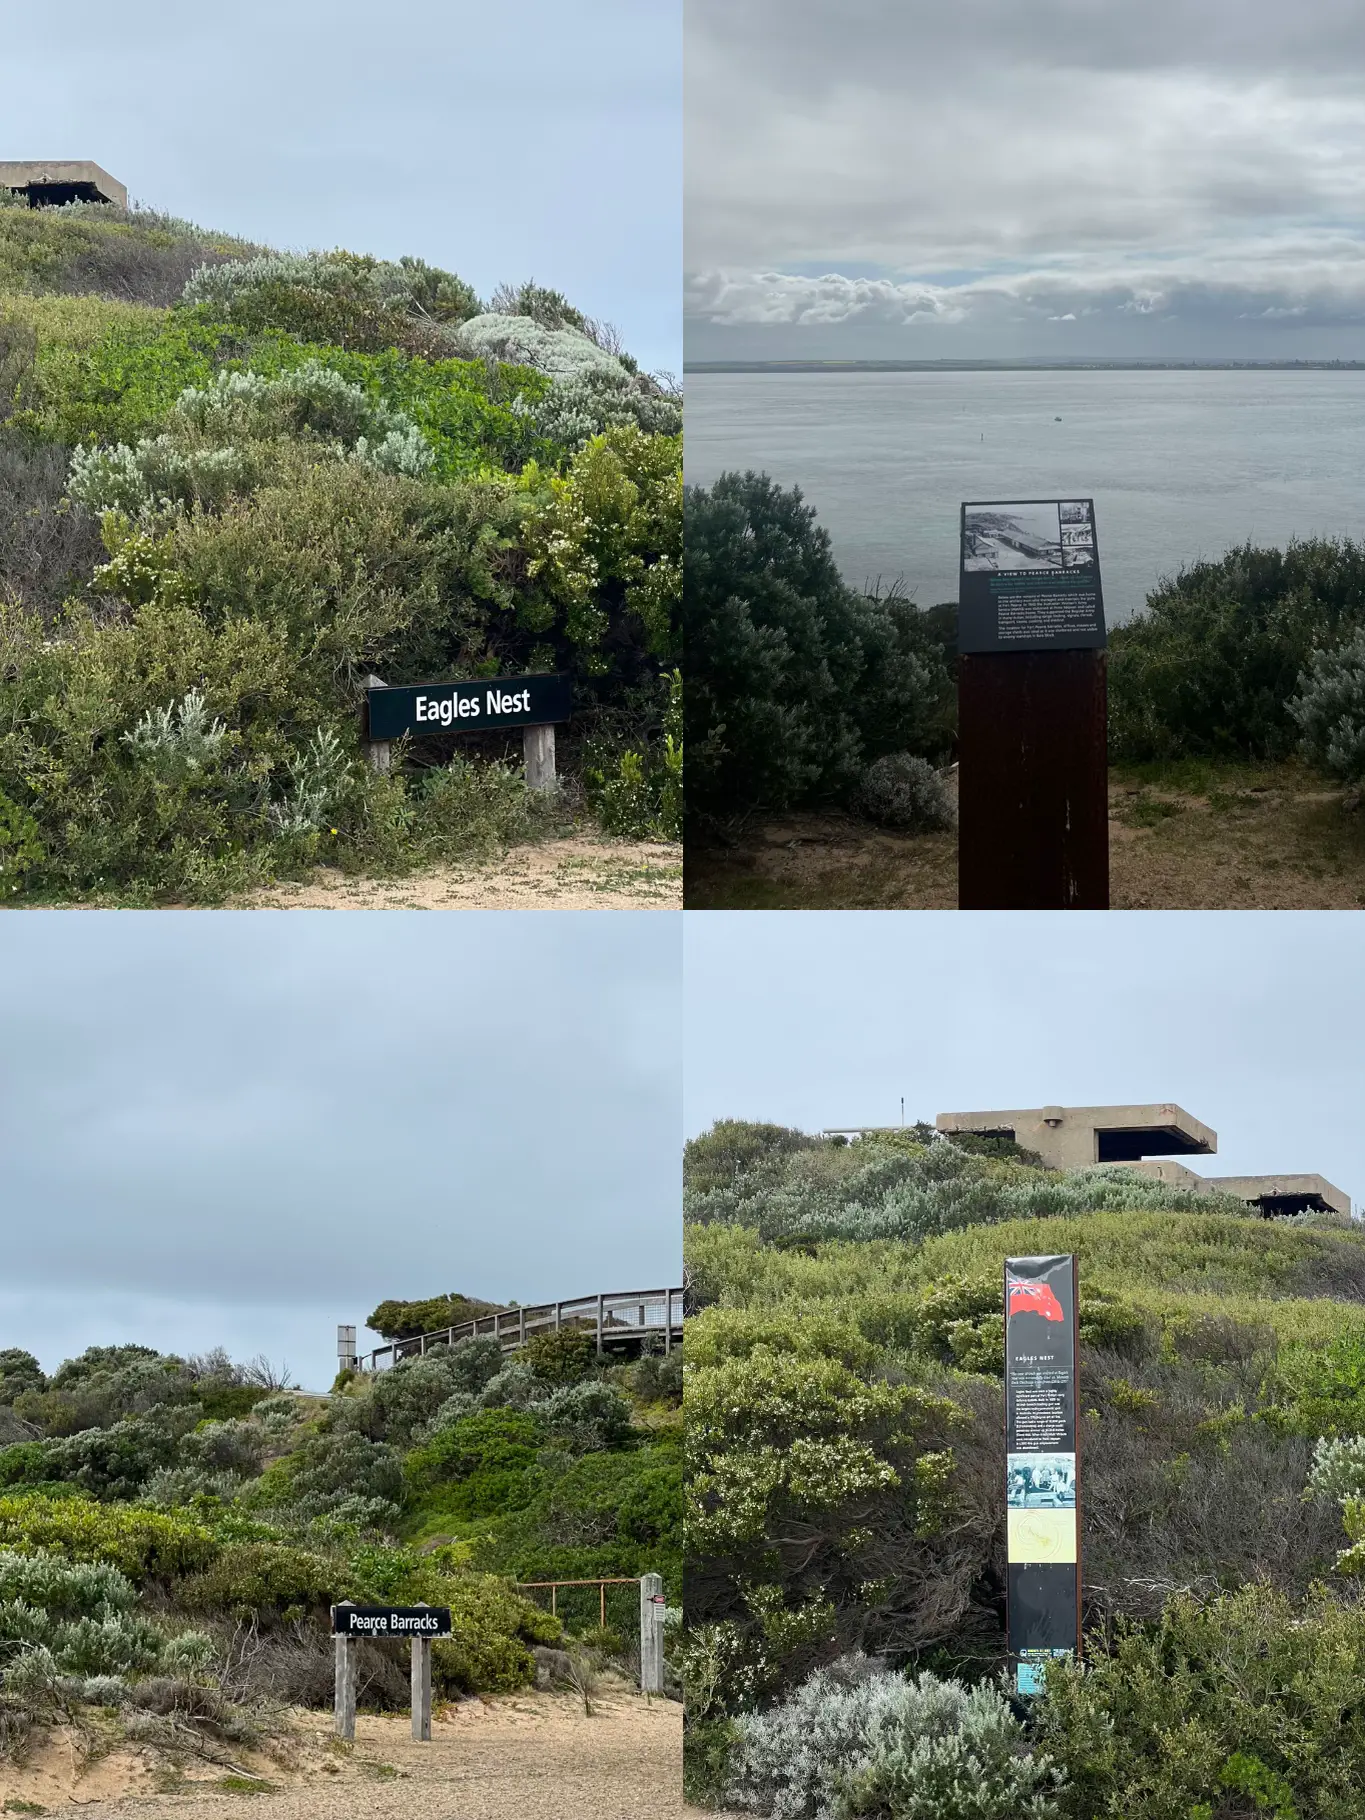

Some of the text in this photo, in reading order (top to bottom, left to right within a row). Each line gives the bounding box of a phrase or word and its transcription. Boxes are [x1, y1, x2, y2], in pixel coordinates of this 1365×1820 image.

[415, 689, 531, 726] Eagles Nest
[349, 1613, 438, 1630] Pearce Barracks
